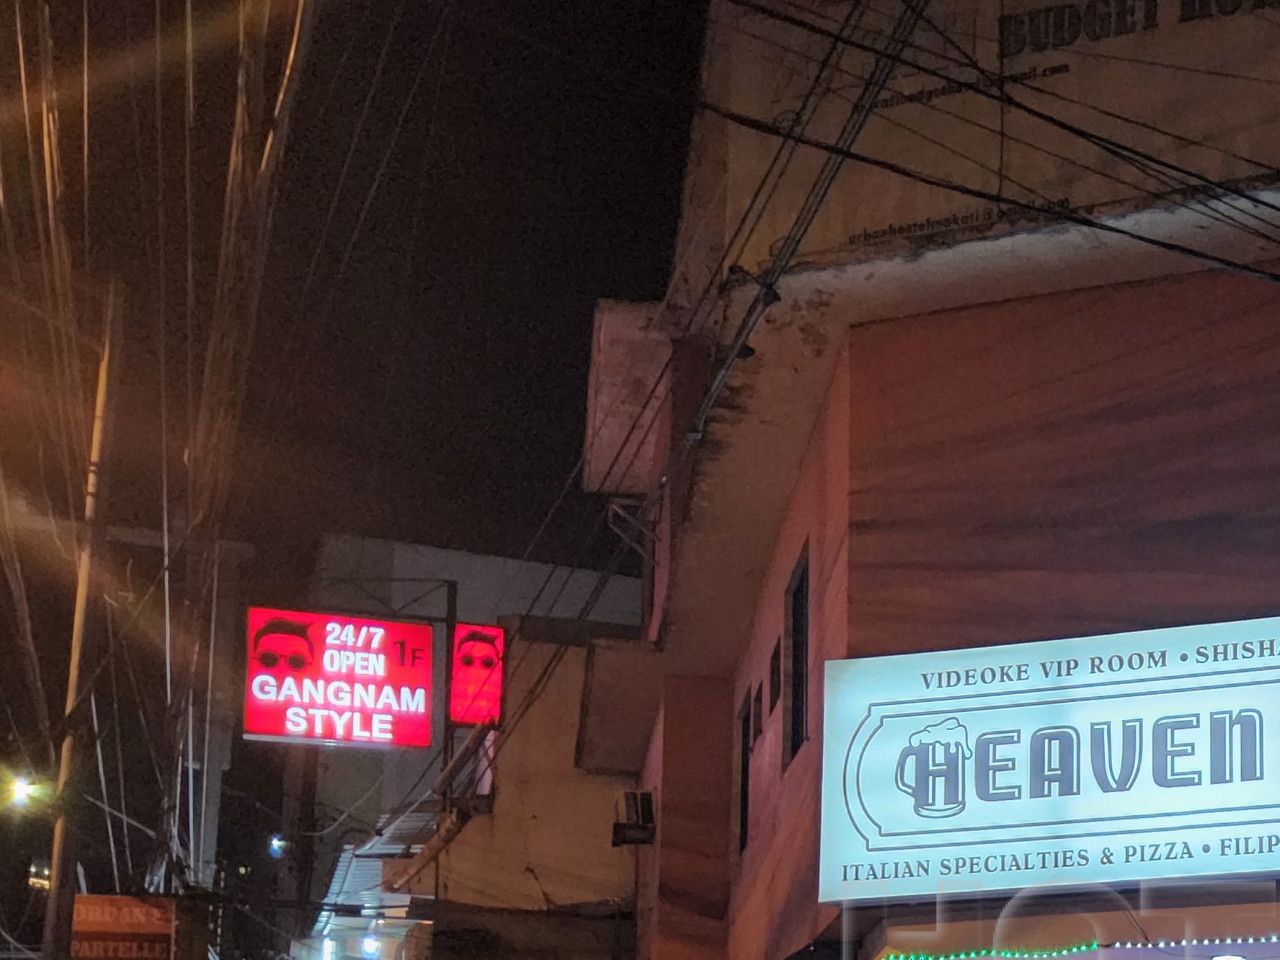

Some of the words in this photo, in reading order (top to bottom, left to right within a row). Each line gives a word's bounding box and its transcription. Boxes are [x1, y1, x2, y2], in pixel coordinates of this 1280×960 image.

[325, 621, 384, 648] 24/7
[322, 649, 385, 676] OPEN
[920, 663, 1030, 689] VIDEOKE
[1039, 659, 1080, 679] VIP
[1089, 650, 1168, 675] ROOM
[251, 674, 426, 713] GANGNAM
[285, 706, 393, 740] STYLE
[913, 710, 1265, 806] HEAVEN
[841, 859, 931, 882] ITALIAN
[939, 848, 1090, 876] SPECIALTIES
[1099, 846, 1116, 865] &
[1124, 841, 1195, 864] PIZZA
